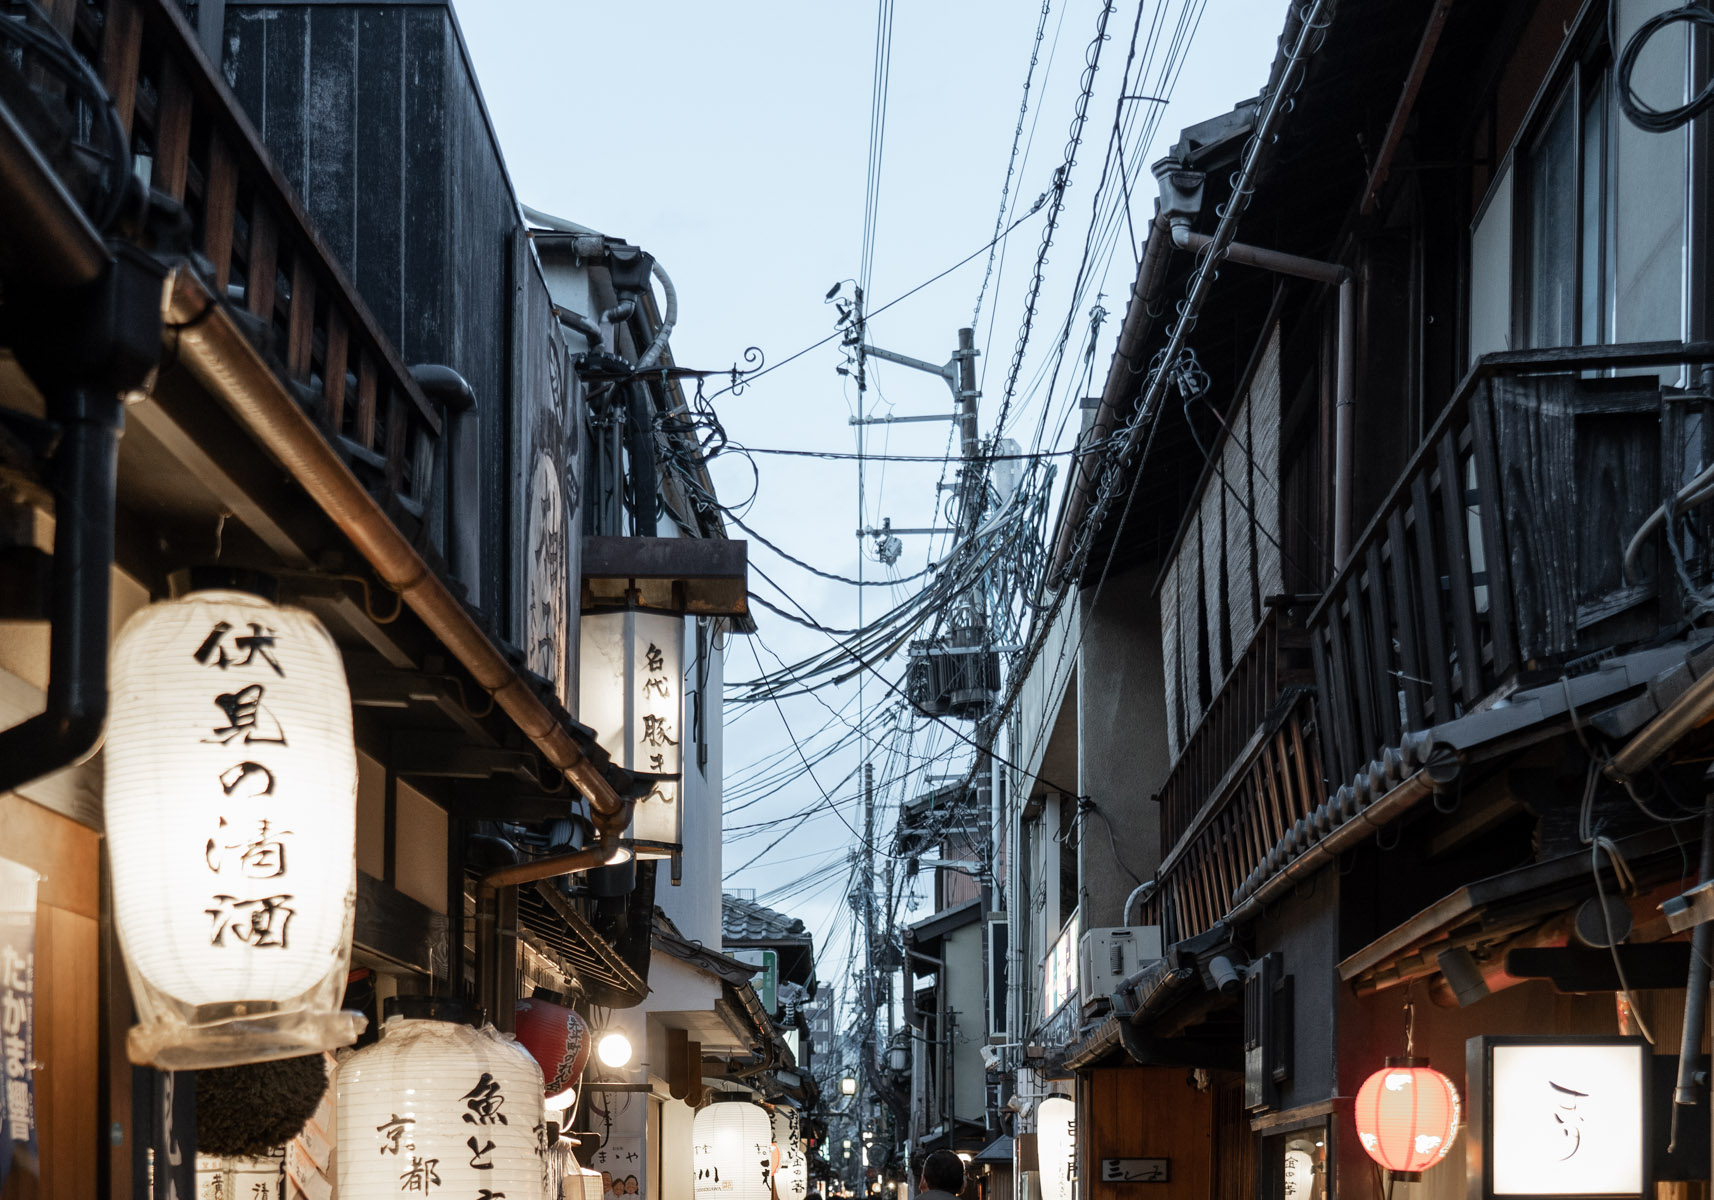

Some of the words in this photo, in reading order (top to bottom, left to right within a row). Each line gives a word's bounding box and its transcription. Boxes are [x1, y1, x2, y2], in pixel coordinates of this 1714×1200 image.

[193, 622, 296, 949] 伏見の清酒
